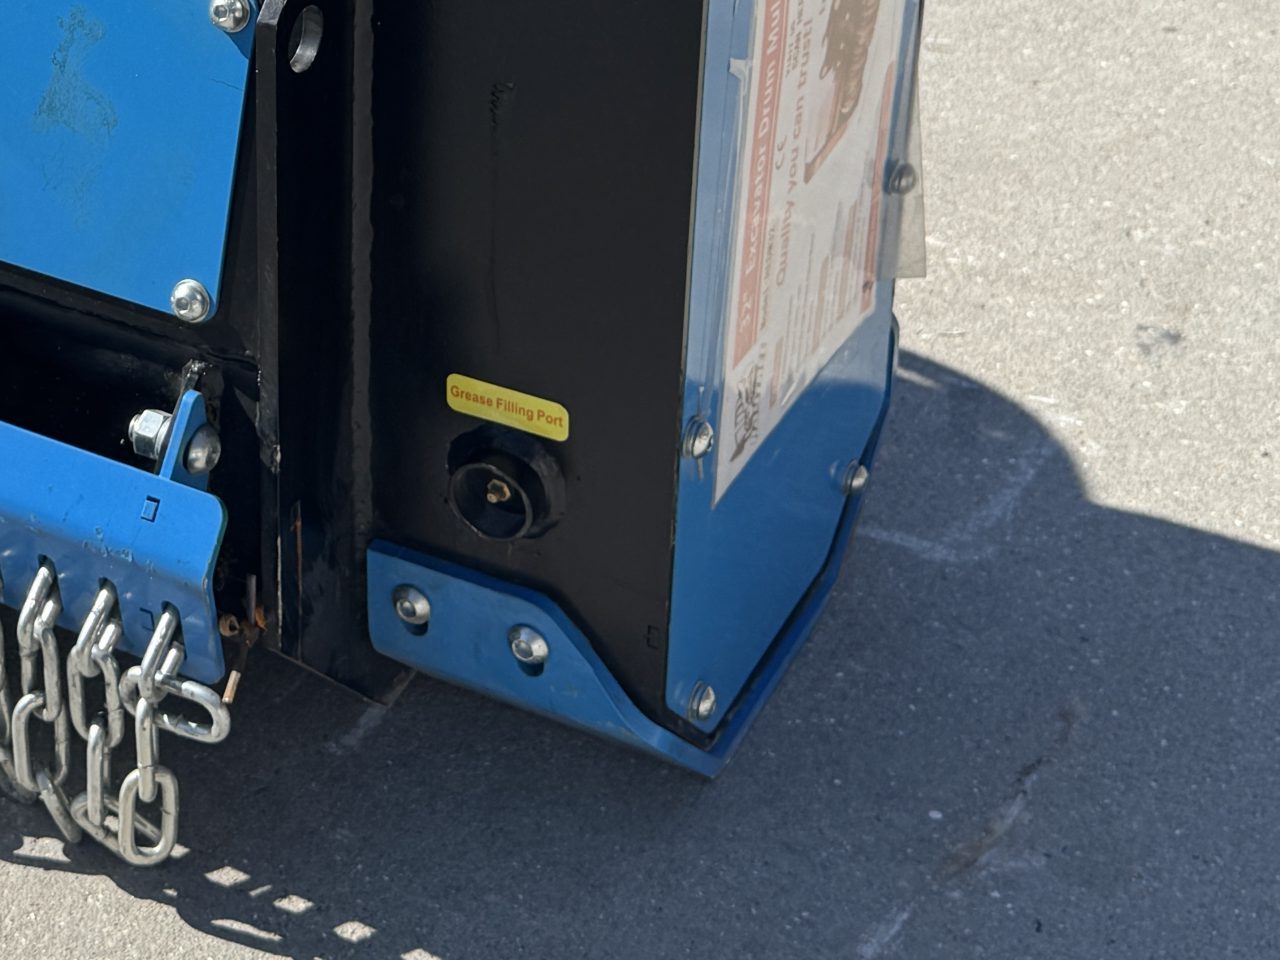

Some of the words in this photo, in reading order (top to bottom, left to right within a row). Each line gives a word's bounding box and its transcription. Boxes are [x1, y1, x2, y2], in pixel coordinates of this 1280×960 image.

[792, 95, 805, 139] can
[746, 143, 766, 275] Excavator
[758, 60, 777, 139] Drum
[786, 145, 800, 193] you
[775, 200, 796, 287] Quality
[450, 385, 493, 407] Grease
[496, 397, 534, 421] Filling
[537, 409, 564, 428] Port
